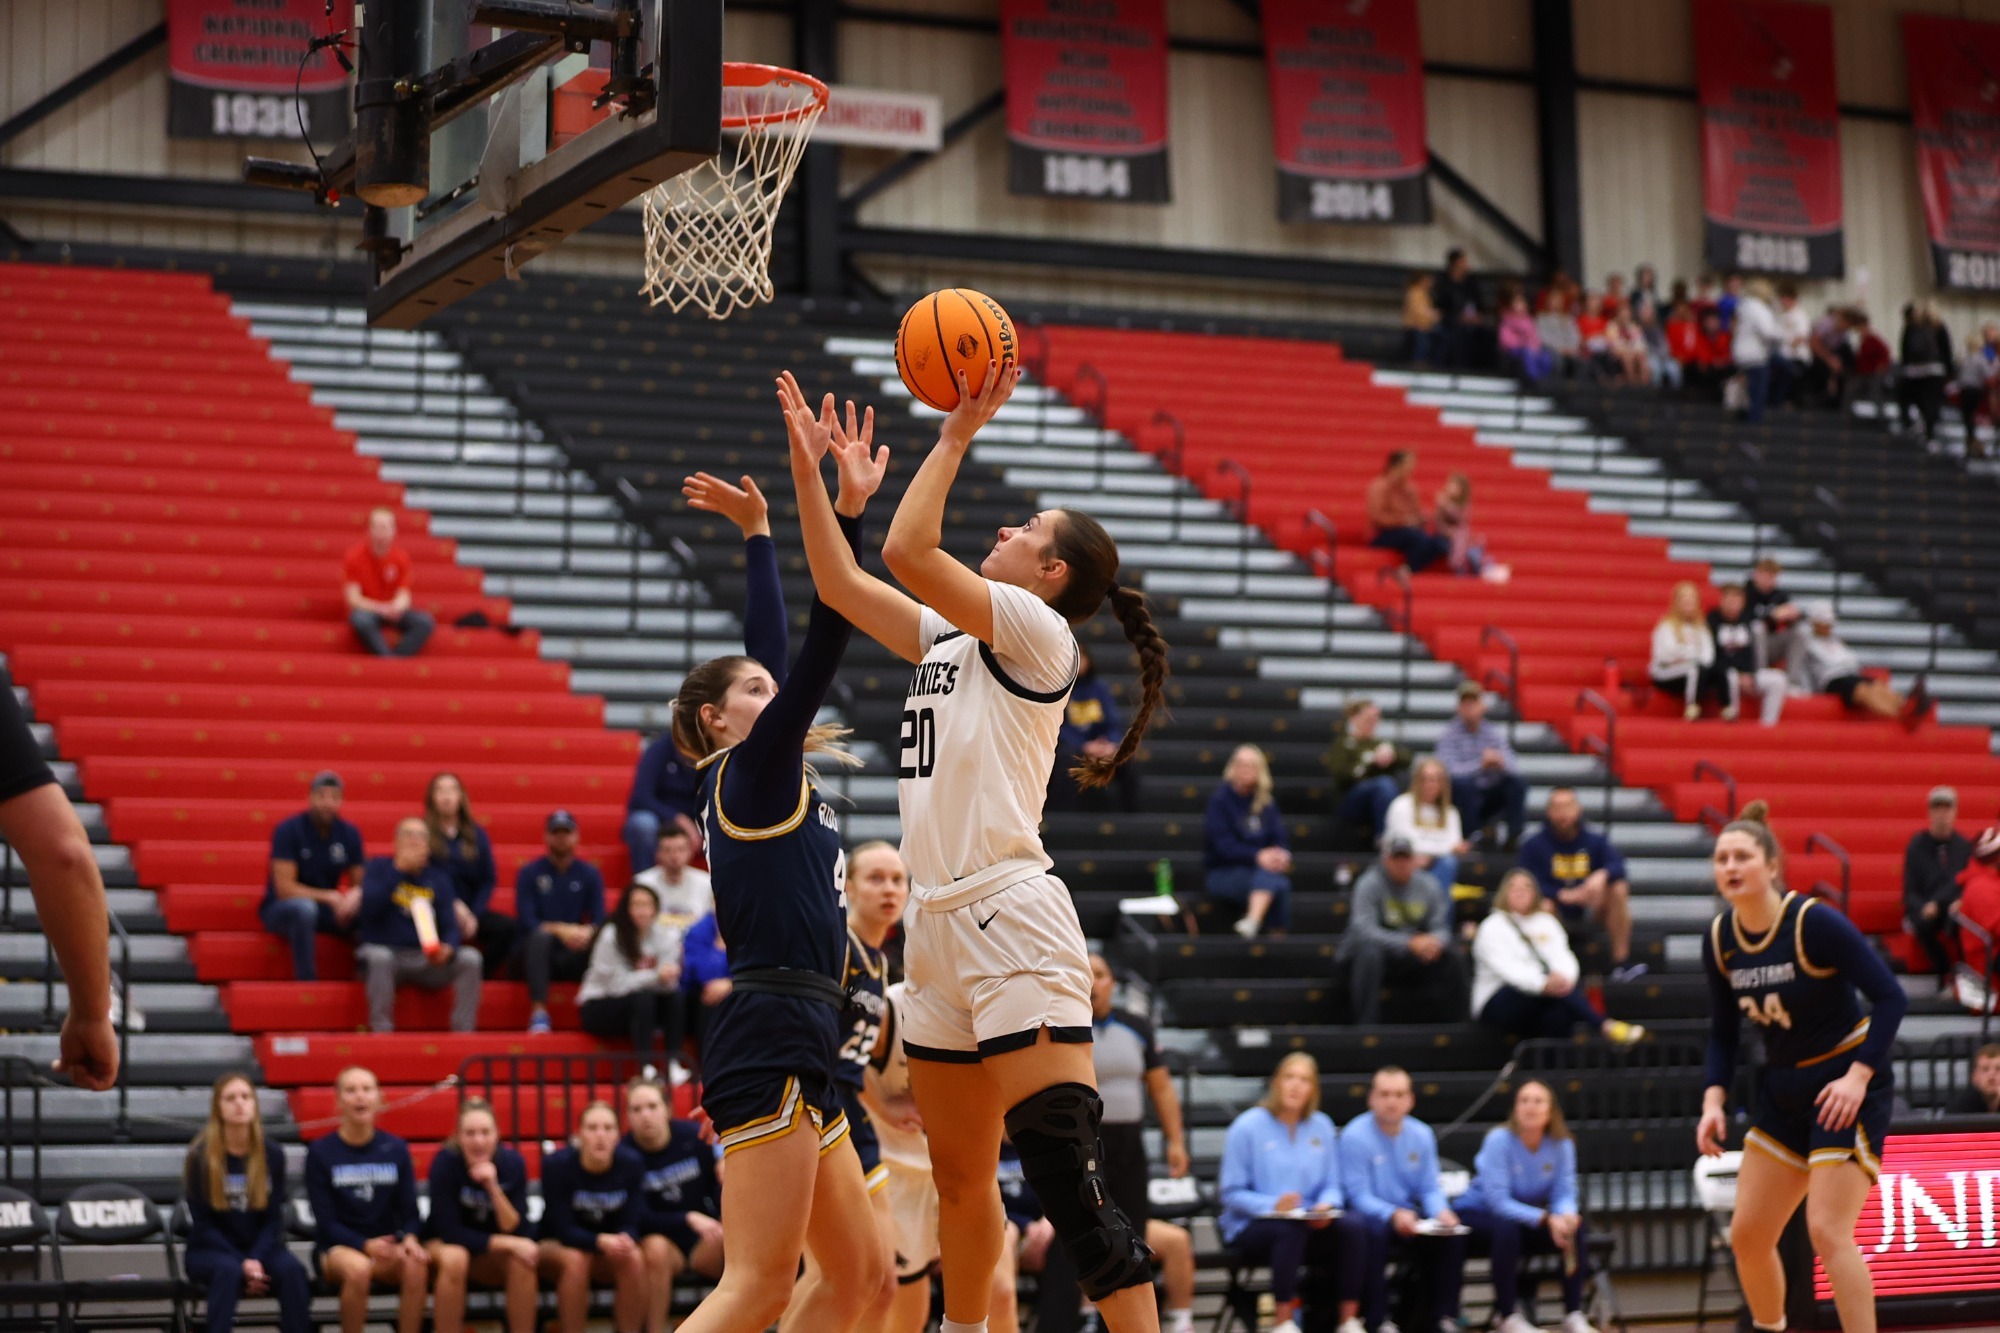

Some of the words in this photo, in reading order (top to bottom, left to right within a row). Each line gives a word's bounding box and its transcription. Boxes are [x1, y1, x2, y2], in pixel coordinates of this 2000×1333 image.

[212, 92, 311, 138] 1938
[825, 102, 927, 133] DMISSION
[1043, 155, 1131, 197] 1984
[1311, 181, 1393, 220] 2014
[1736, 234, 1809, 273] 2015
[1950, 253, 2000, 289] 201
[908, 662, 960, 698] NNIES
[900, 707, 935, 779] 20
[69, 1198, 148, 1228] UCM
